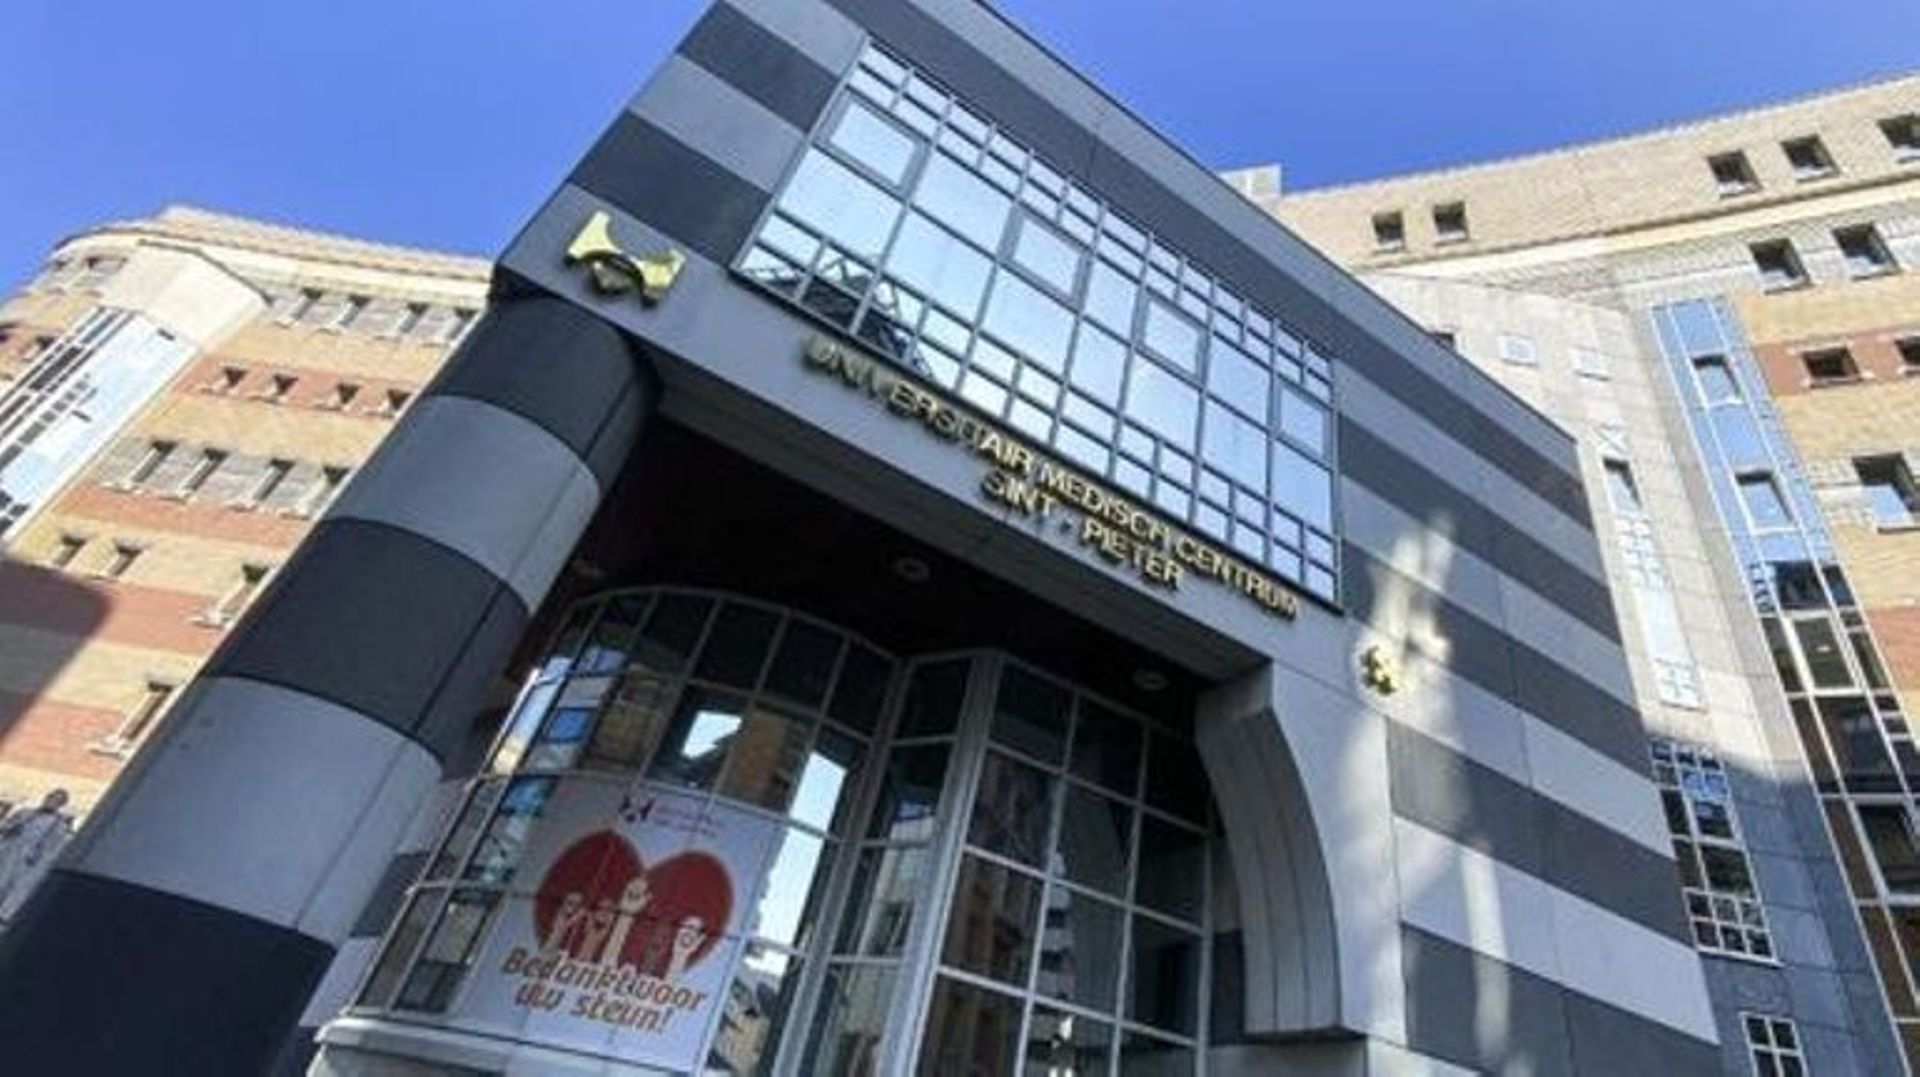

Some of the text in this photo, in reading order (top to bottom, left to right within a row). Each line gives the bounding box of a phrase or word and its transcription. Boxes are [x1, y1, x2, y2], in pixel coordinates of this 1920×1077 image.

[981, 470, 1056, 520] SINT
[1080, 518, 1184, 591] PIETER
[1039, 462, 1171, 546] MEDISCH
[1175, 535, 1297, 619] CENTRUM
[570, 992, 674, 1034] steun!
